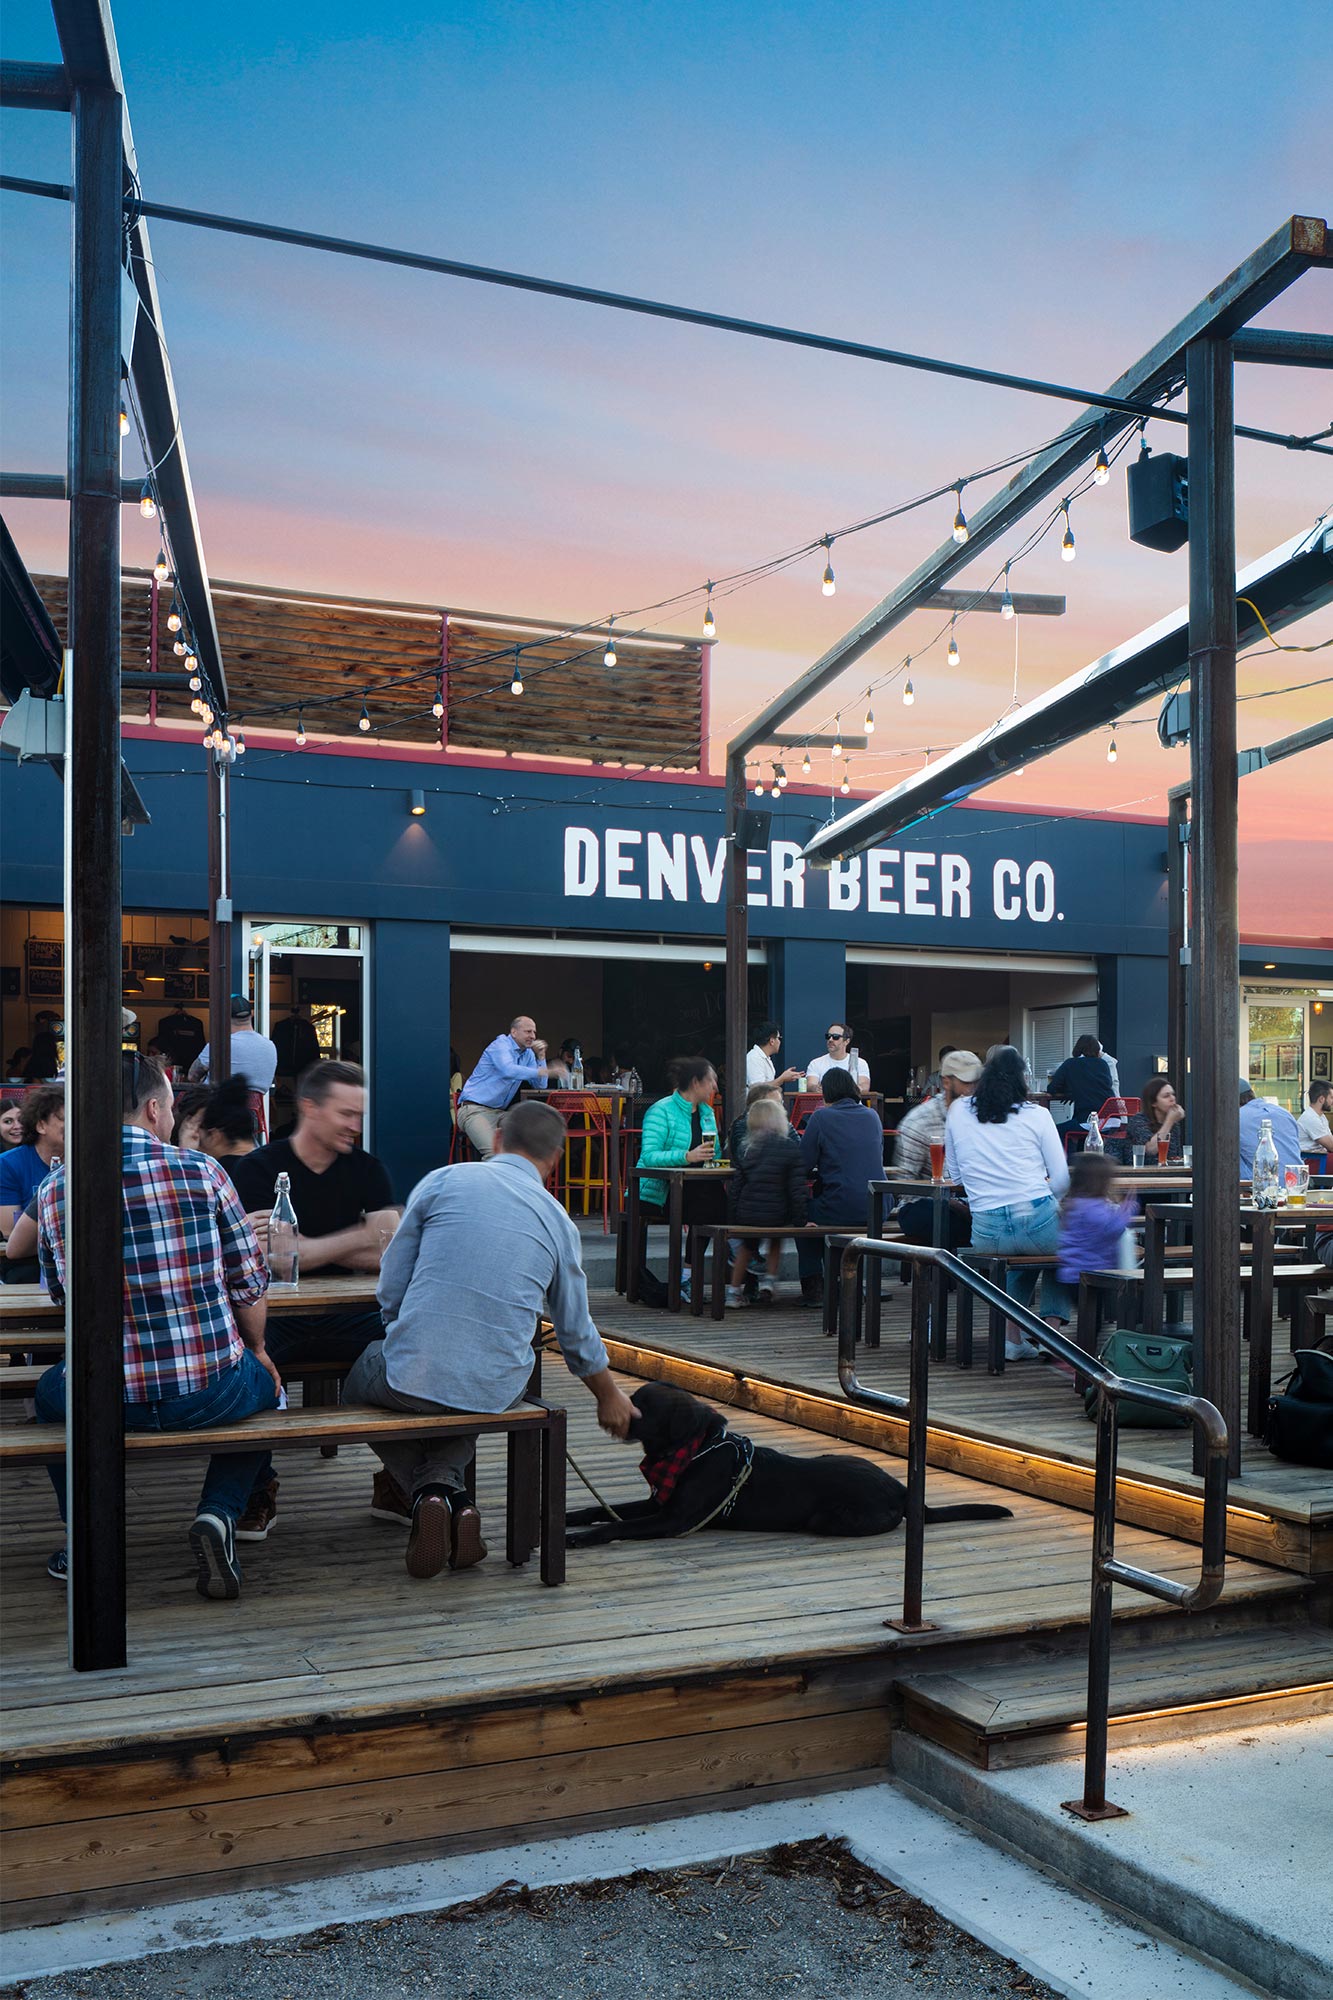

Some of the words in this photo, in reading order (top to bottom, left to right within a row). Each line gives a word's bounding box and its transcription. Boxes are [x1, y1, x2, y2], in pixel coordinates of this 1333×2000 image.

[564, 826, 805, 908] DENVER
[829, 848, 972, 918] BEER
[993, 859, 1064, 922] CO.
